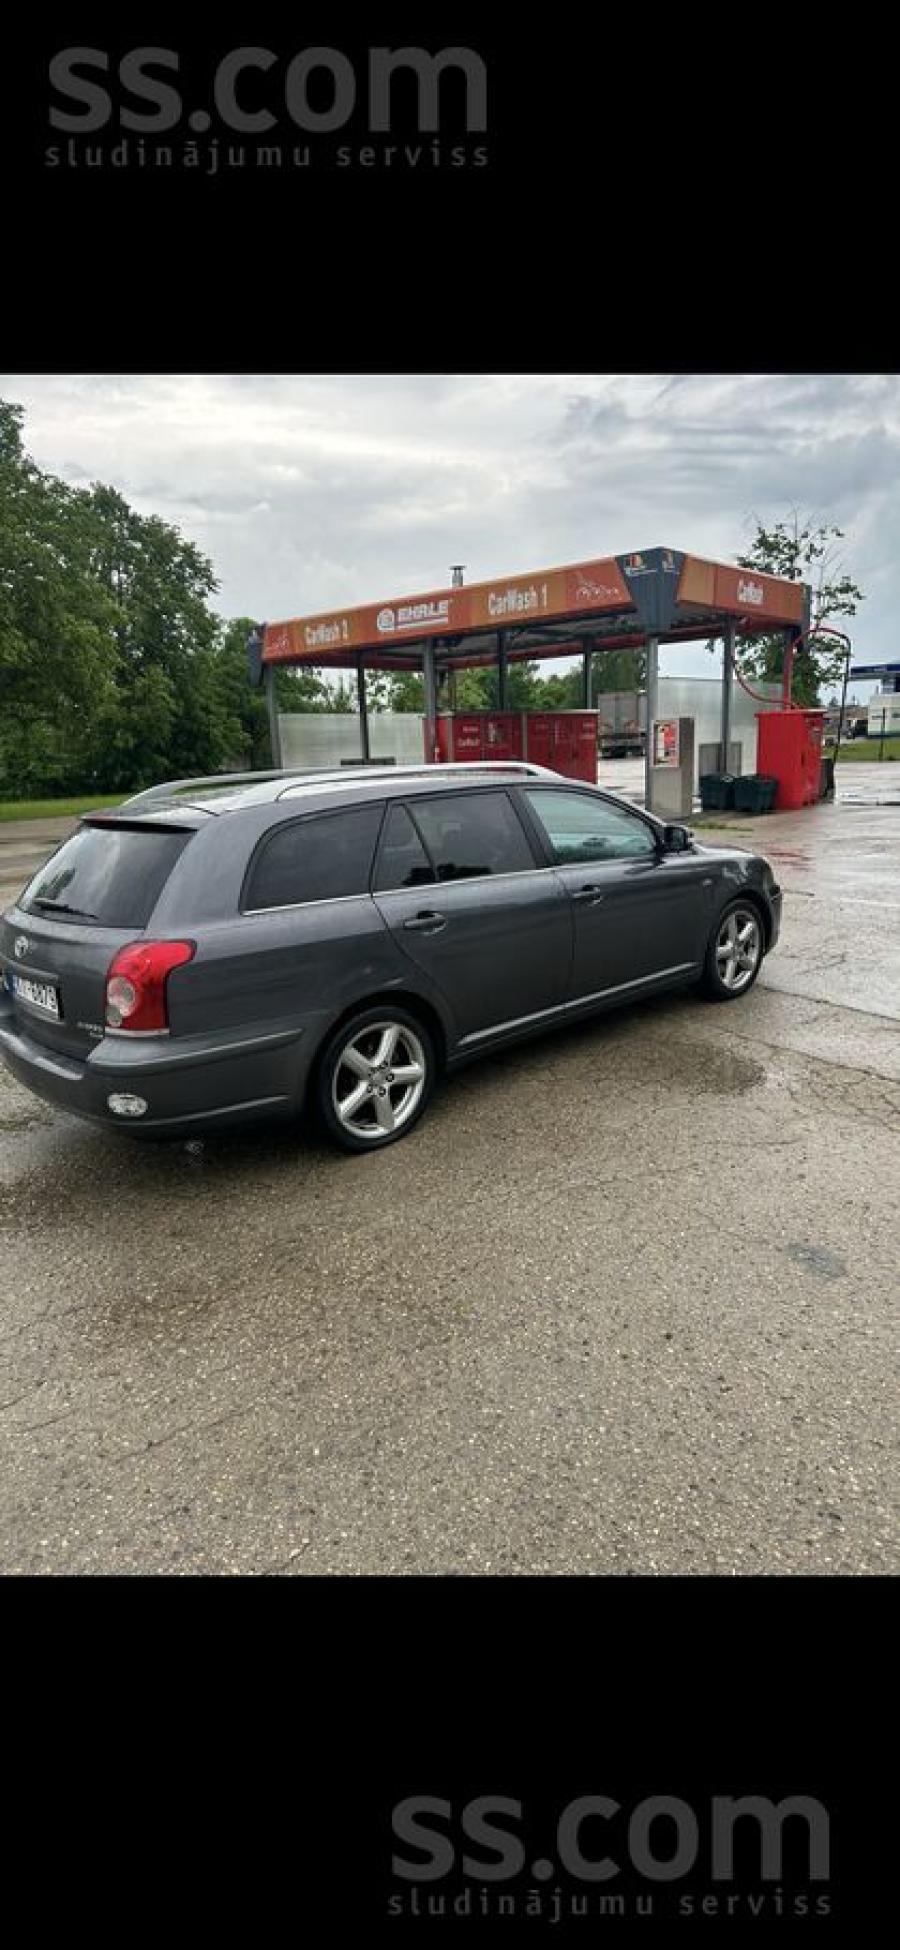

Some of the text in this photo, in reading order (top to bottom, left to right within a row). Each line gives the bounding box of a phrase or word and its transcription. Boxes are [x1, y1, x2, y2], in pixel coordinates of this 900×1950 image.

[398, 600, 449, 622] EHRLE
[488, 585, 539, 616] CarWash
[303, 621, 341, 646] CarWash
